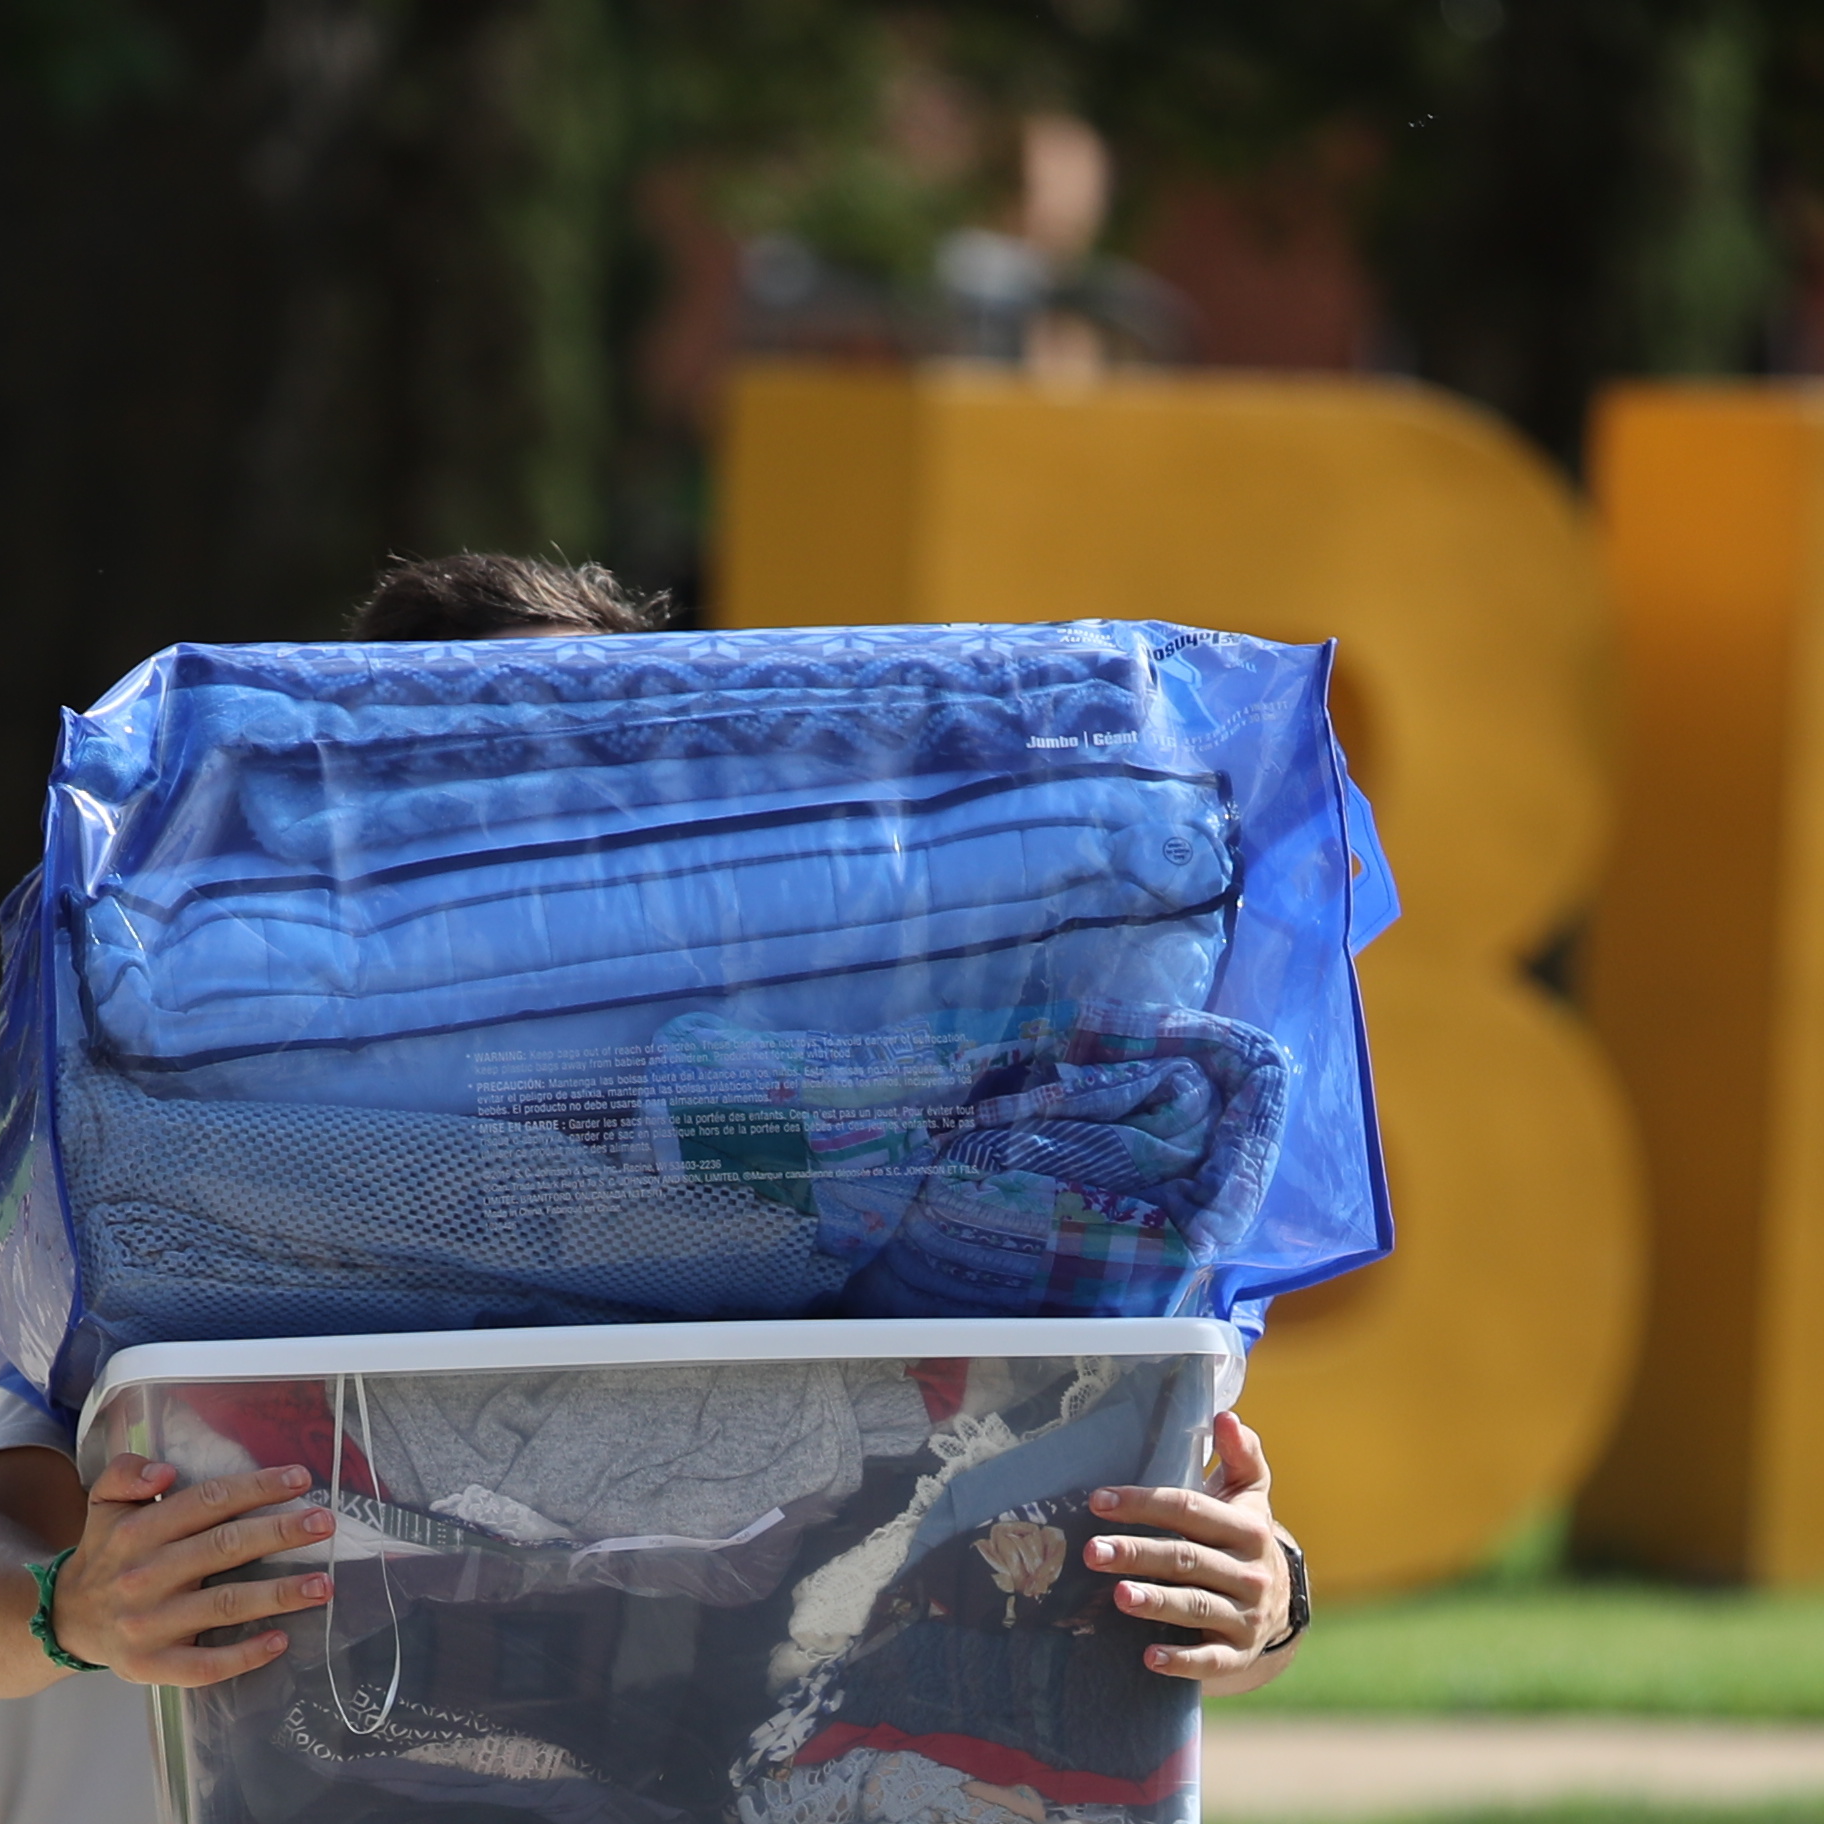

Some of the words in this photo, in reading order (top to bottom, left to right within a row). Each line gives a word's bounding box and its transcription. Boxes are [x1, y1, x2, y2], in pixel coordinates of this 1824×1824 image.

[1025, 734, 1079, 749] Jumbo
[1092, 730, 1139, 746] Géant
[473, 1051, 527, 1063] WARNING:
[529, 1050, 554, 1063] Keep
[583, 1048, 599, 1058] out
[601, 1047, 612, 1057] of
[614, 1046, 642, 1057] reach
[644, 1046, 655, 1055] of
[778, 1039, 795, 1048] not
[474, 1065, 499, 1077] keep
[561, 1063, 587, 1073] away
[589, 1059, 612, 1070] from
[614, 1058, 647, 1069] babies
[648, 1056, 667, 1065] and
[713, 1052, 751, 1063] Product
[752, 1051, 769, 1061] not
[476, 1079, 546, 1093] PRECAUCIÓN:
[548, 1078, 597, 1092] Mantenga
[599, 1077, 614, 1087] las
[617, 1075, 649, 1086] bolsas
[651, 1073, 677, 1084] fuera
[738, 1070, 752, 1080] de
[949, 1063, 972, 1073] Para
[476, 1094, 504, 1105] evitar
[507, 1093, 517, 1103] el
[519, 1092, 553, 1105] peligro
[555, 1091, 568, 1101] de
[607, 1087, 657, 1101] mantenga
[658, 1086, 673, 1096] las
[675, 1084, 708, 1094] bolsas
[783, 1080, 798, 1090] del
[855, 1078, 871, 1087] los
[958, 1076, 973, 1085] los
[512, 1105, 522, 1115] El
[524, 1103, 567, 1116] producto
[584, 1101, 608, 1111] debe
[610, 1102, 642, 1110] usarse
[644, 1101, 666, 1111] para
[668, 1096, 719, 1107] almacenar
[721, 1093, 772, 1104] alimentos.
[479, 1123, 505, 1134] MISE
[507, 1123, 522, 1133] EN
[524, 1121, 560, 1132] GARDE
[568, 1119, 601, 1130] Garder
[603, 1118, 618, 1129] les
[620, 1120, 642, 1128] sacs
[645, 1116, 666, 1127] hors
[668, 1115, 681, 1125] de
[683, 1115, 693, 1125] la
[695, 1113, 726, 1126] portée
[728, 1112, 746, 1123] des
[748, 1110, 787, 1122] enfants.
[838, 1112, 857, 1122] pas
[859, 1111, 871, 1119] un
[873, 1108, 901, 1120] jouet.
[902, 1106, 924, 1117] Pour
[926, 1105, 953, 1115] éviter
[955, 1104, 975, 1114] tout
[568, 1132, 601, 1145] garder
[652, 1128, 696, 1141] plastique
[698, 1127, 721, 1137] hors
[722, 1126, 736, 1136] de
[738, 1125, 747, 1135] la
[749, 1124, 781, 1137] portée
[783, 1123, 801, 1133] des
[847, 1122, 865, 1131] des
[941, 1119, 956, 1129] Ne
[958, 1120, 976, 1130] pas
[590, 1145, 608, 1155] des
[609, 1143, 653, 1154] aliments.
[872, 1169, 884, 1177] de
[946, 1166, 958, 1175] ET
